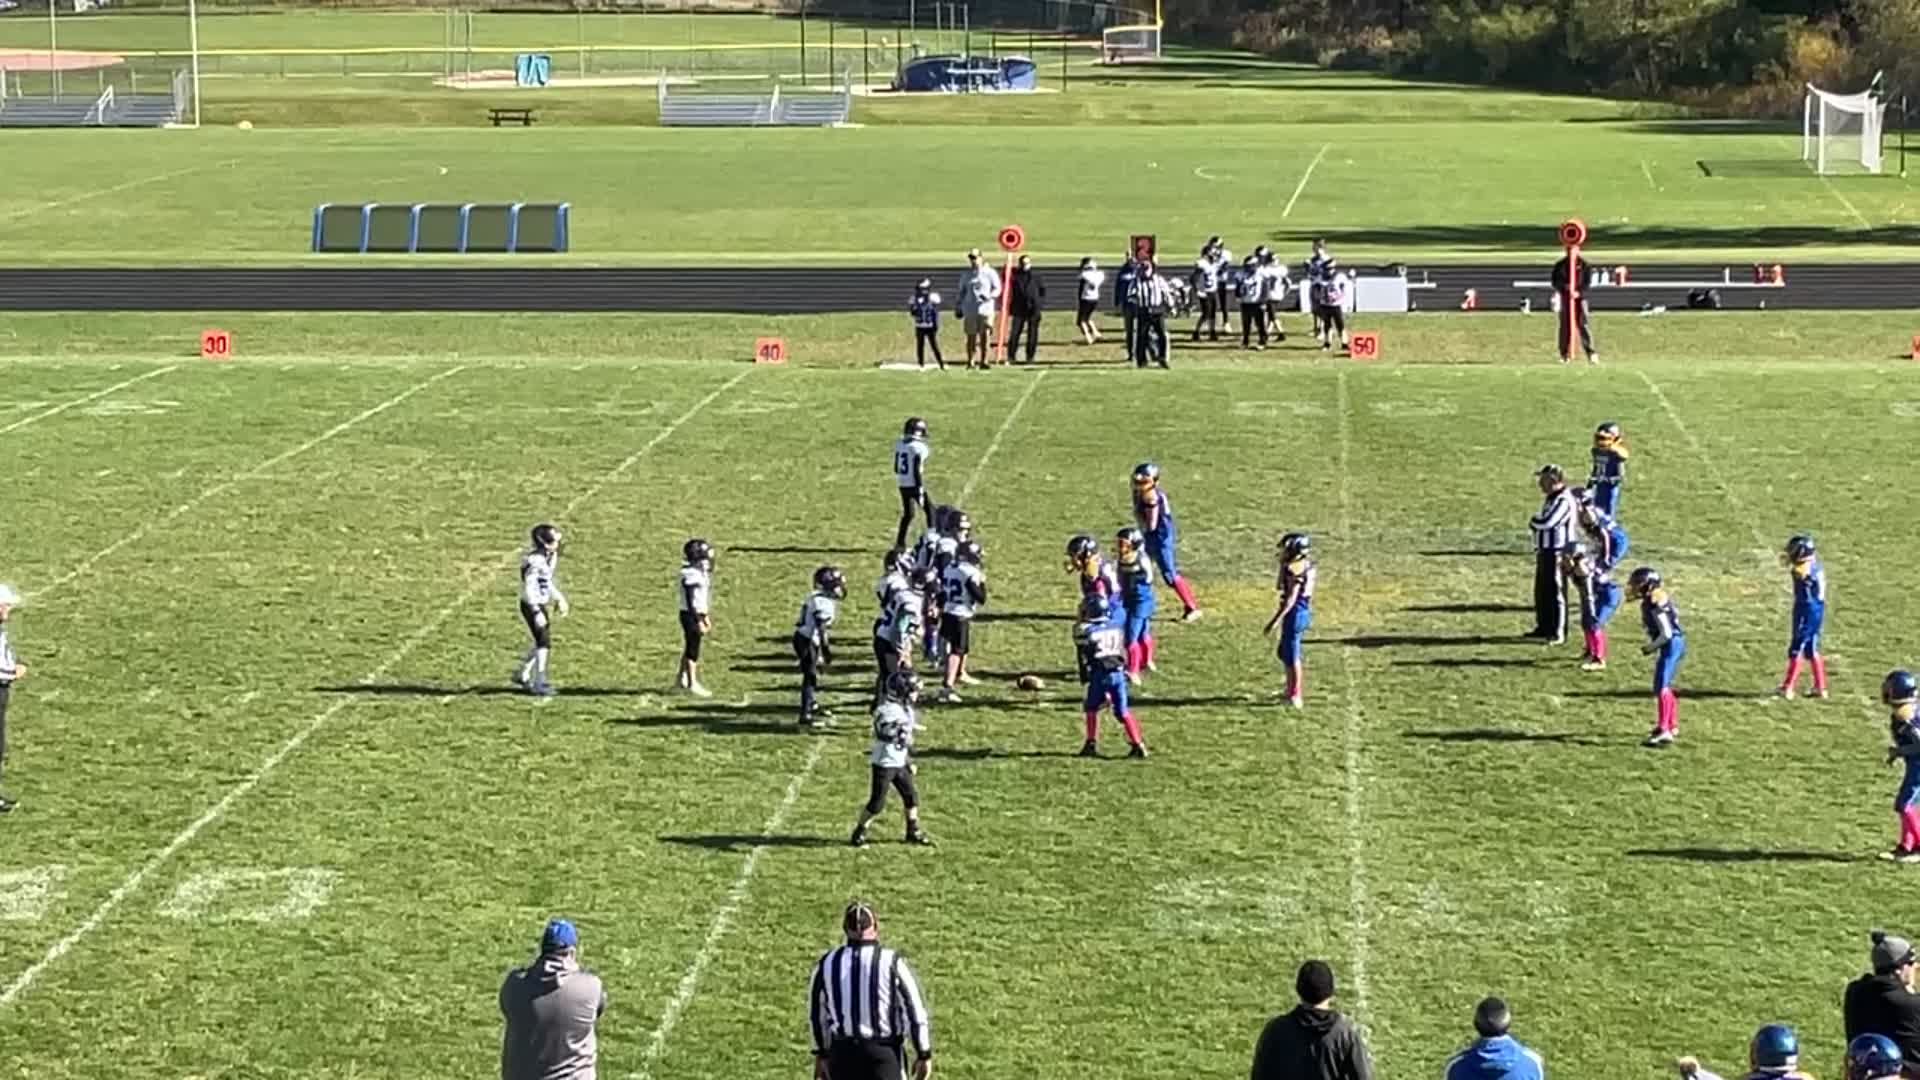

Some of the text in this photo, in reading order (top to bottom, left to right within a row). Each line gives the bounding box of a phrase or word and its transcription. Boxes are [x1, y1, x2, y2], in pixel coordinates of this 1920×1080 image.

[205, 335, 227, 354] 30
[759, 343, 781, 361] 40
[1353, 336, 1375, 355] 50
